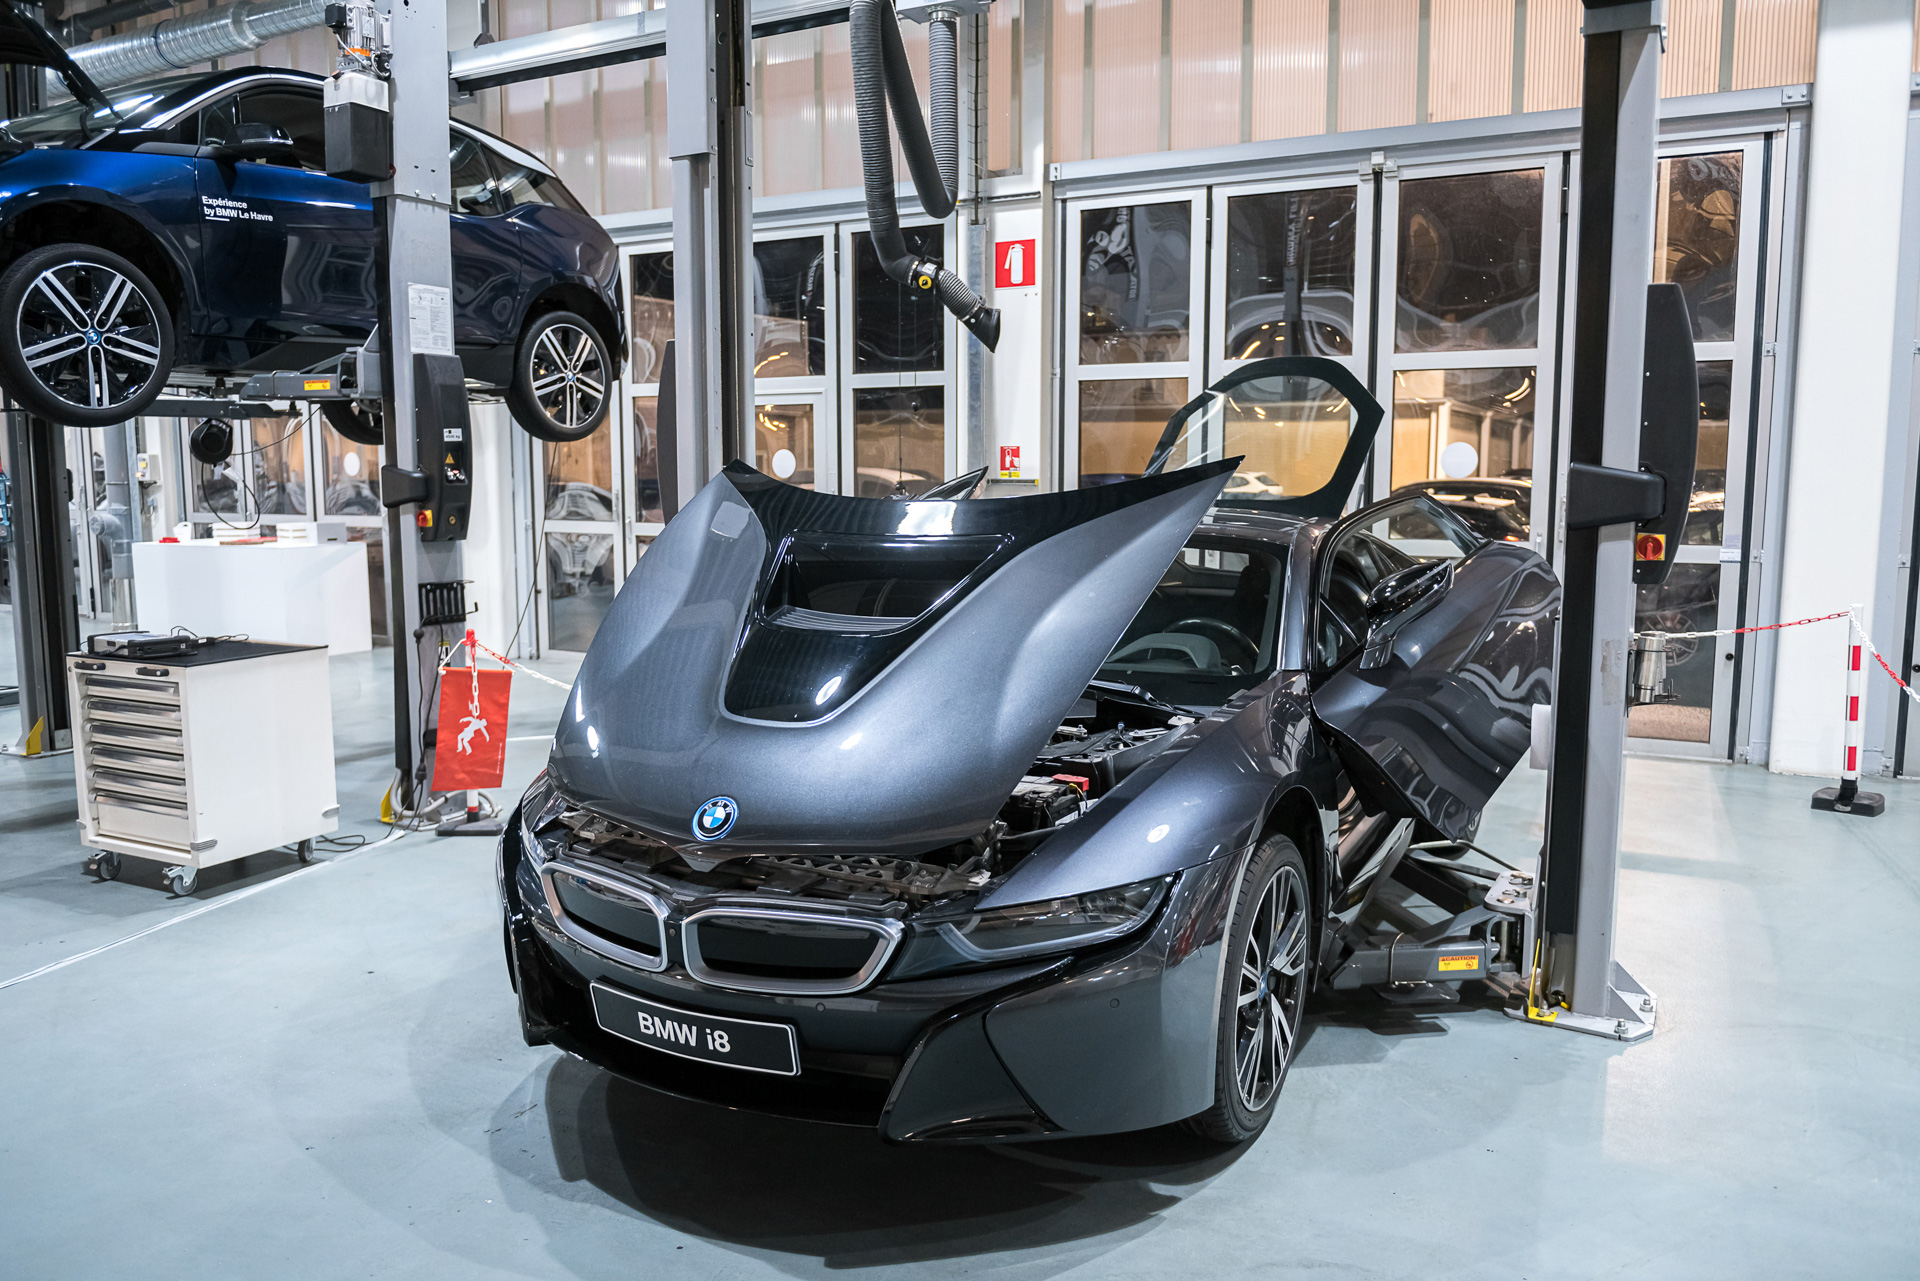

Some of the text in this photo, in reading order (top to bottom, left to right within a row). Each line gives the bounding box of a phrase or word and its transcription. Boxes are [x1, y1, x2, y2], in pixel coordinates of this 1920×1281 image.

[201, 195, 248, 209] Expérience
[203, 206, 274, 222] by BMW Le Havre
[637, 1011, 731, 1053] BMW i8
